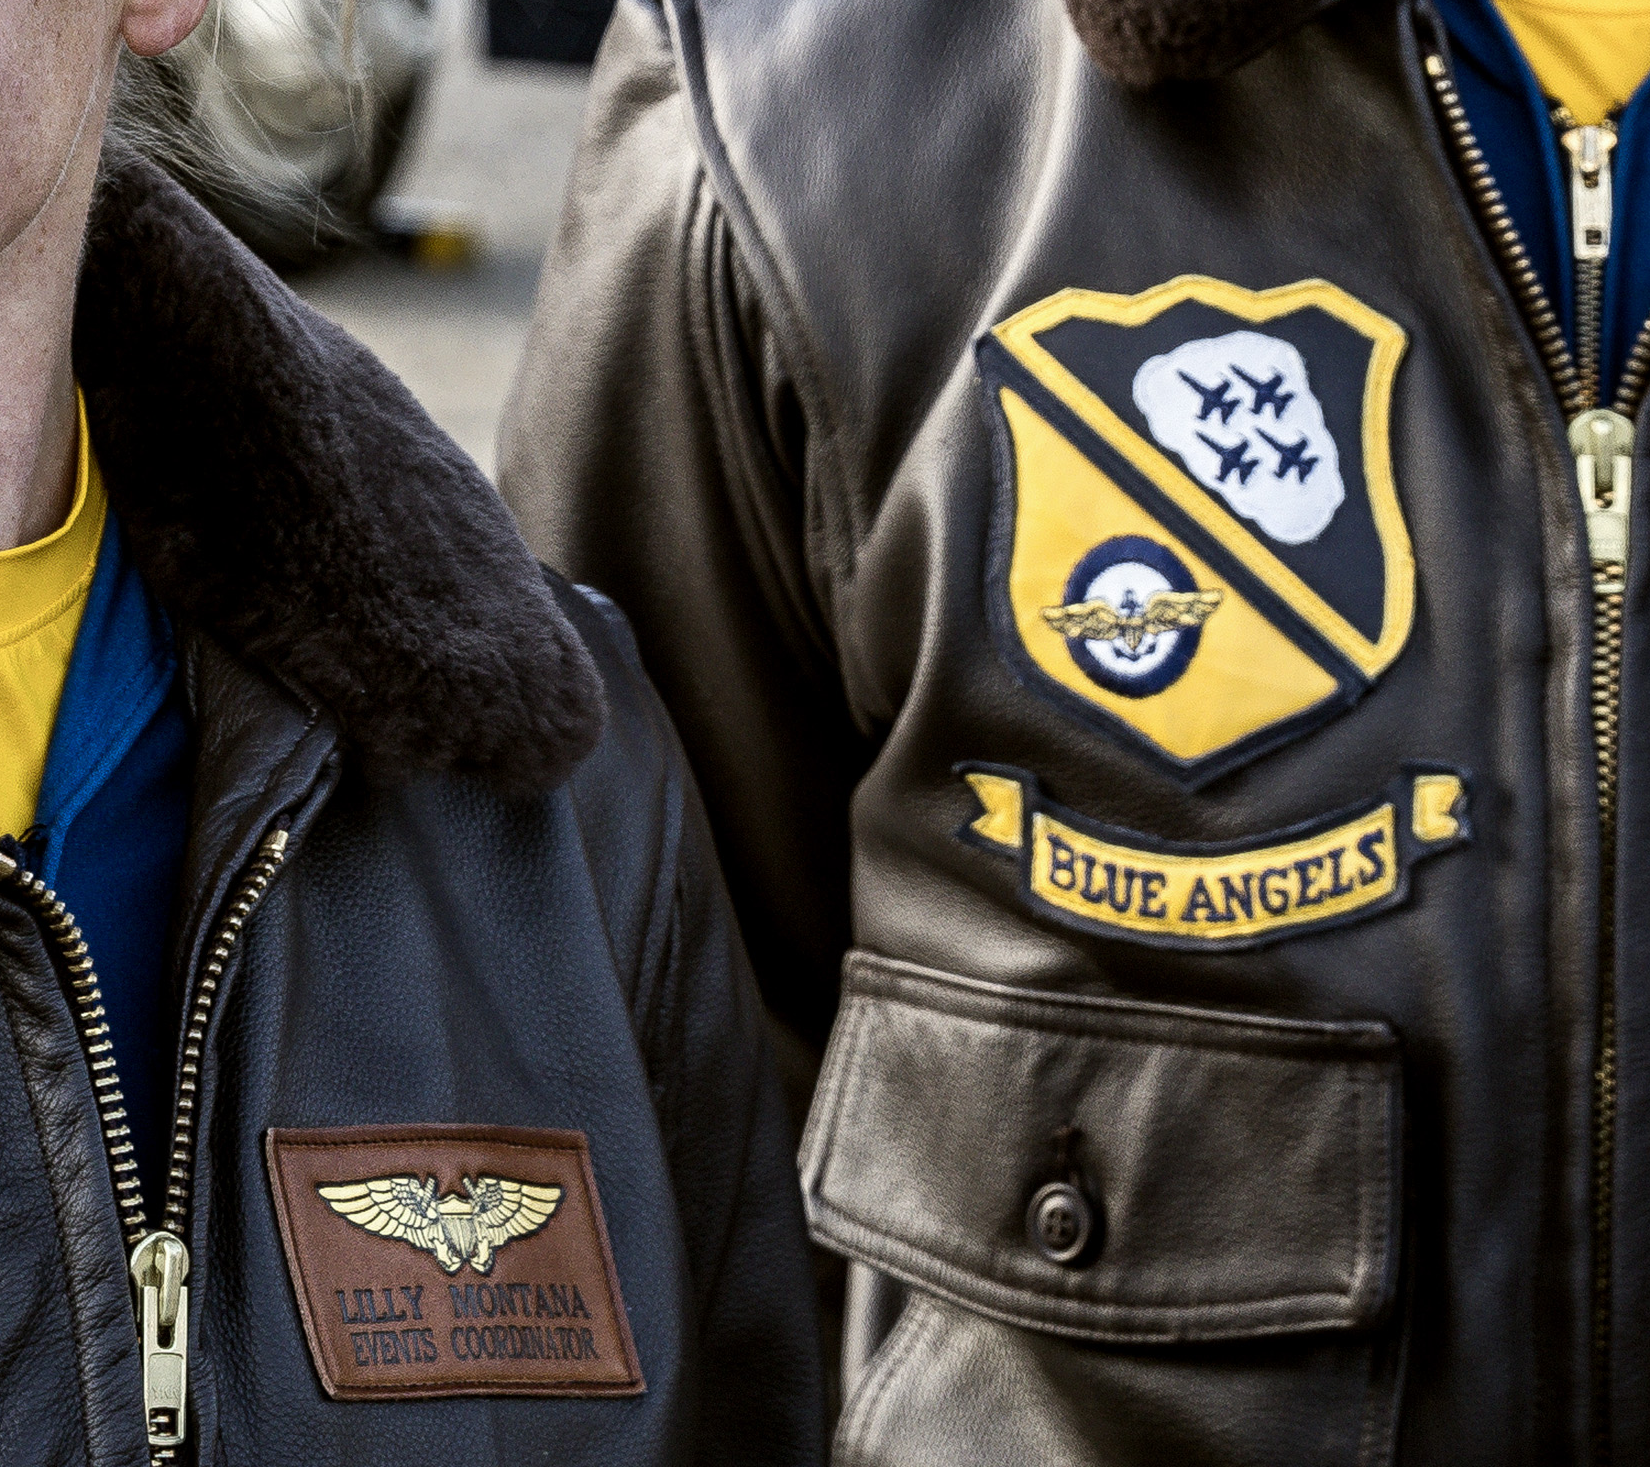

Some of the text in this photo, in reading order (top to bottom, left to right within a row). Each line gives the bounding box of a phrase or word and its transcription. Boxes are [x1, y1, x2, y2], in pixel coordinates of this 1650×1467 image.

[1047, 828, 1385, 923] BLUE ANGELS
[335, 1282, 592, 1325] LILLY MONTANA
[350, 1324, 600, 1366] EVENTS COORDINATOR
